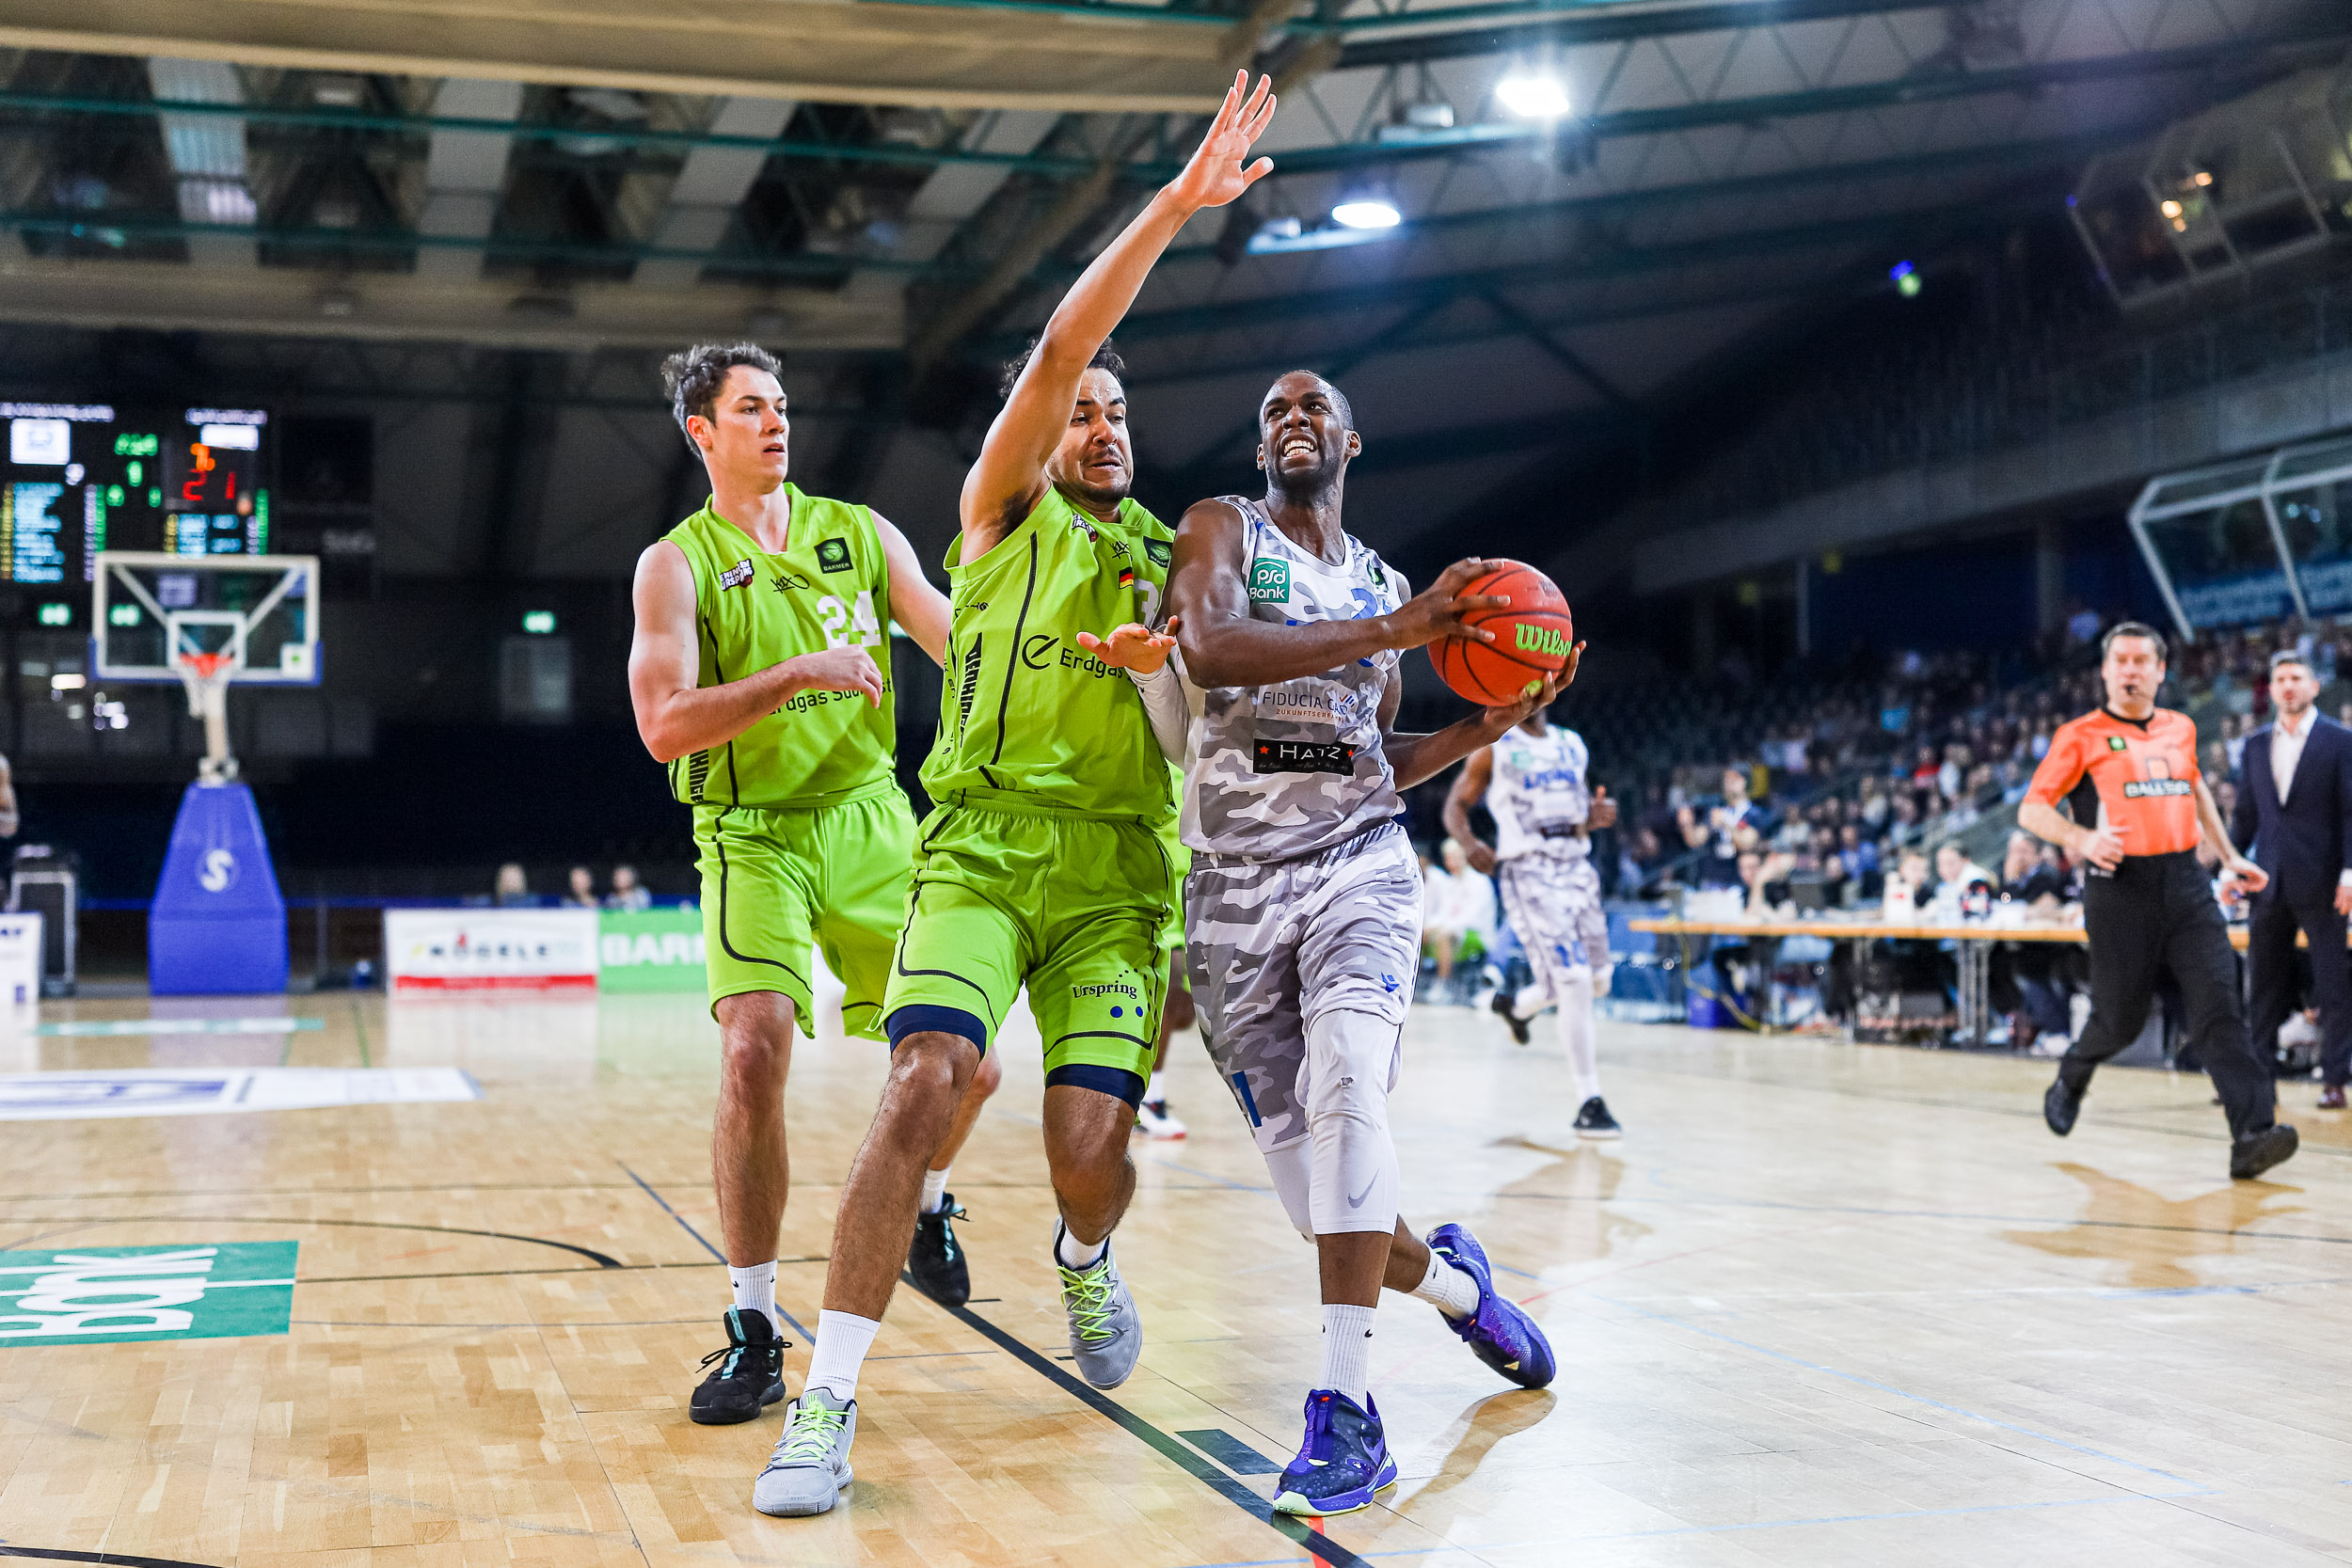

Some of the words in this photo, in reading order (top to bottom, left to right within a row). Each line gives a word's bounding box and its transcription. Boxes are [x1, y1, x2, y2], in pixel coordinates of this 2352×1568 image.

[1257, 569, 1286, 585] psd
[1249, 587, 1286, 600] Bank
[817, 591, 882, 650] 24
[770, 691, 828, 715] dgas
[1263, 691, 1323, 709] FIDUCIA
[1279, 744, 1342, 760] HATZ
[1073, 981, 1137, 1000] Urspring
